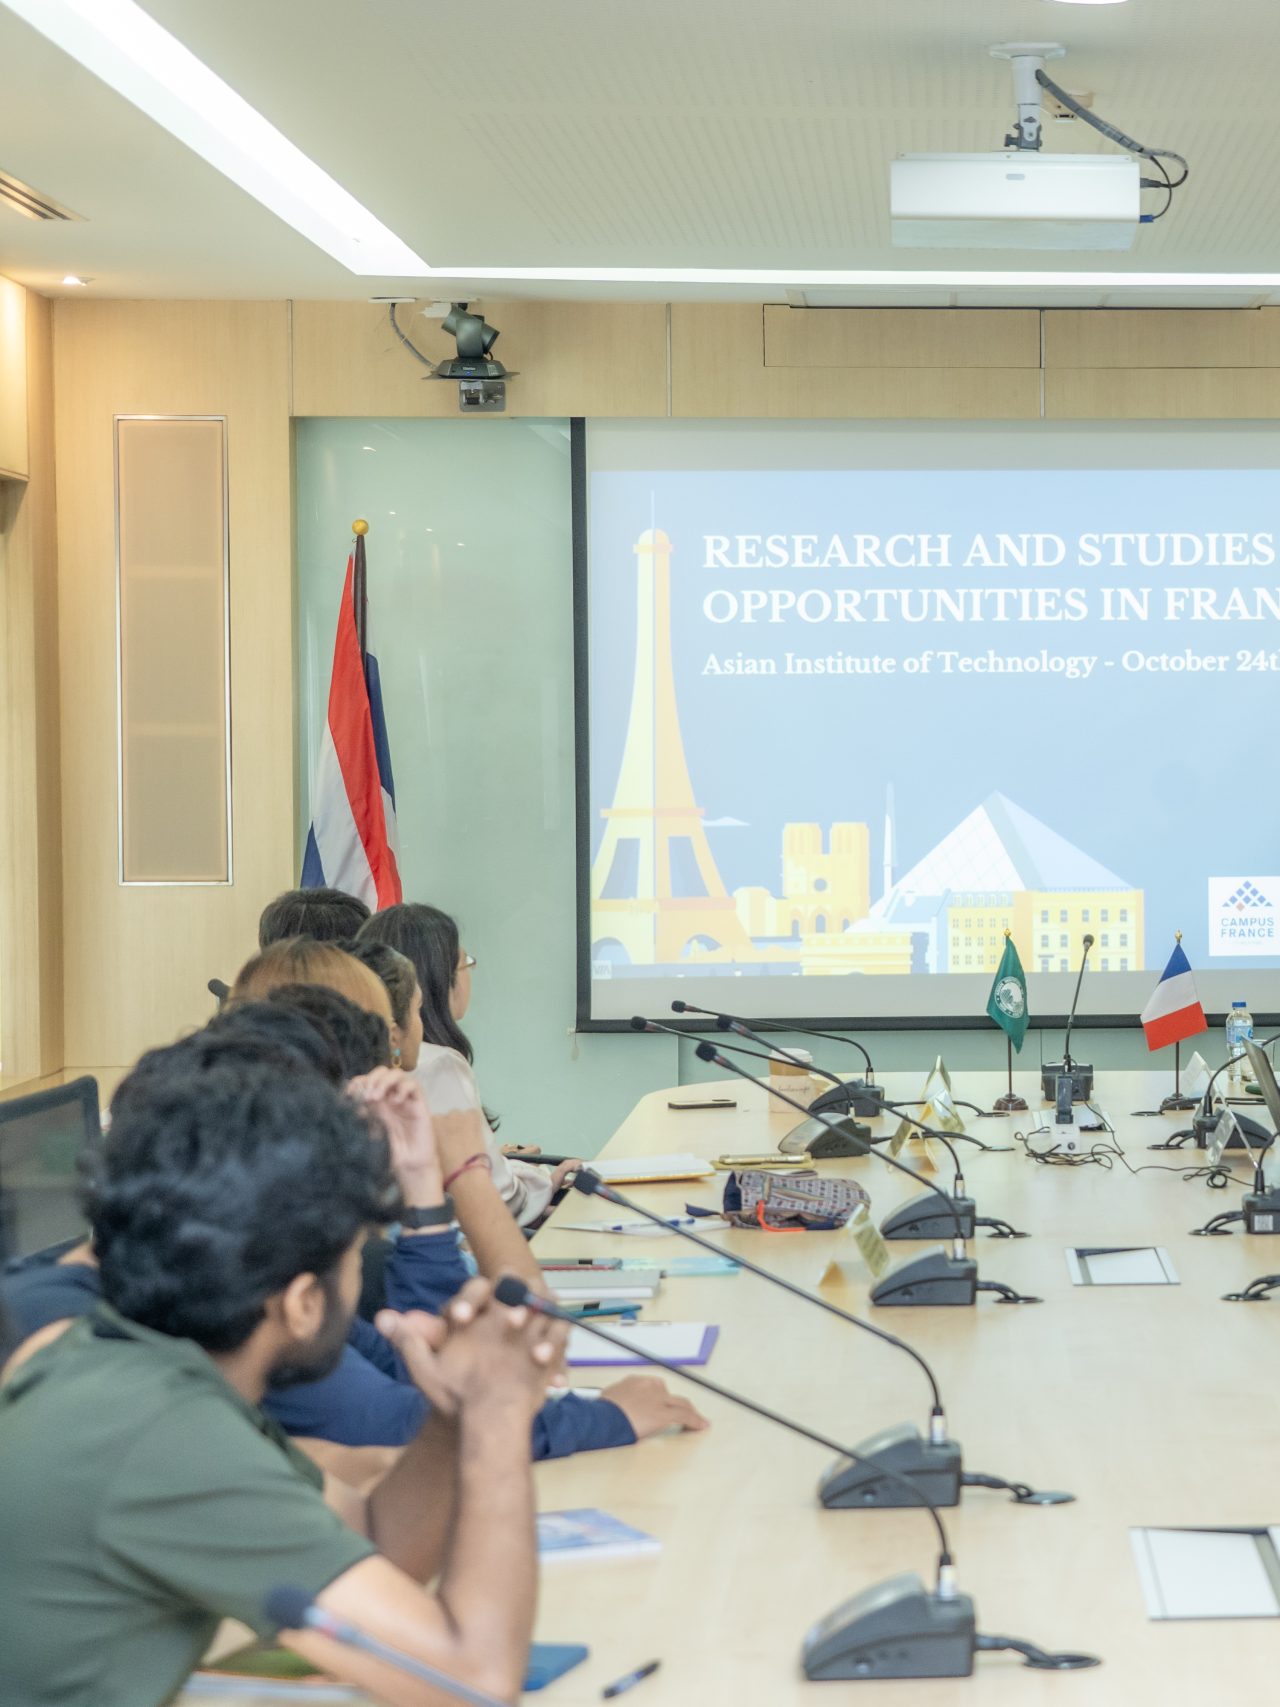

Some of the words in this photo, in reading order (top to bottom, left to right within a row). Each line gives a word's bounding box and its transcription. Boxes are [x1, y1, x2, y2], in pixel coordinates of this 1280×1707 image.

[702, 532, 953, 569] RESEARCH
[962, 532, 1067, 568] AND
[1077, 531, 1276, 568] STUDIES
[702, 586, 1089, 624] OPPORTUNITIES
[1099, 586, 1153, 622] IN
[701, 652, 777, 676] Asian
[783, 650, 897, 676] Institute
[902, 649, 935, 675] of
[937, 648, 1098, 679] Technology
[1121, 647, 1231, 673] October
[1220, 917, 1275, 927] CAMPUS
[1220, 927, 1275, 938] FRANCE
